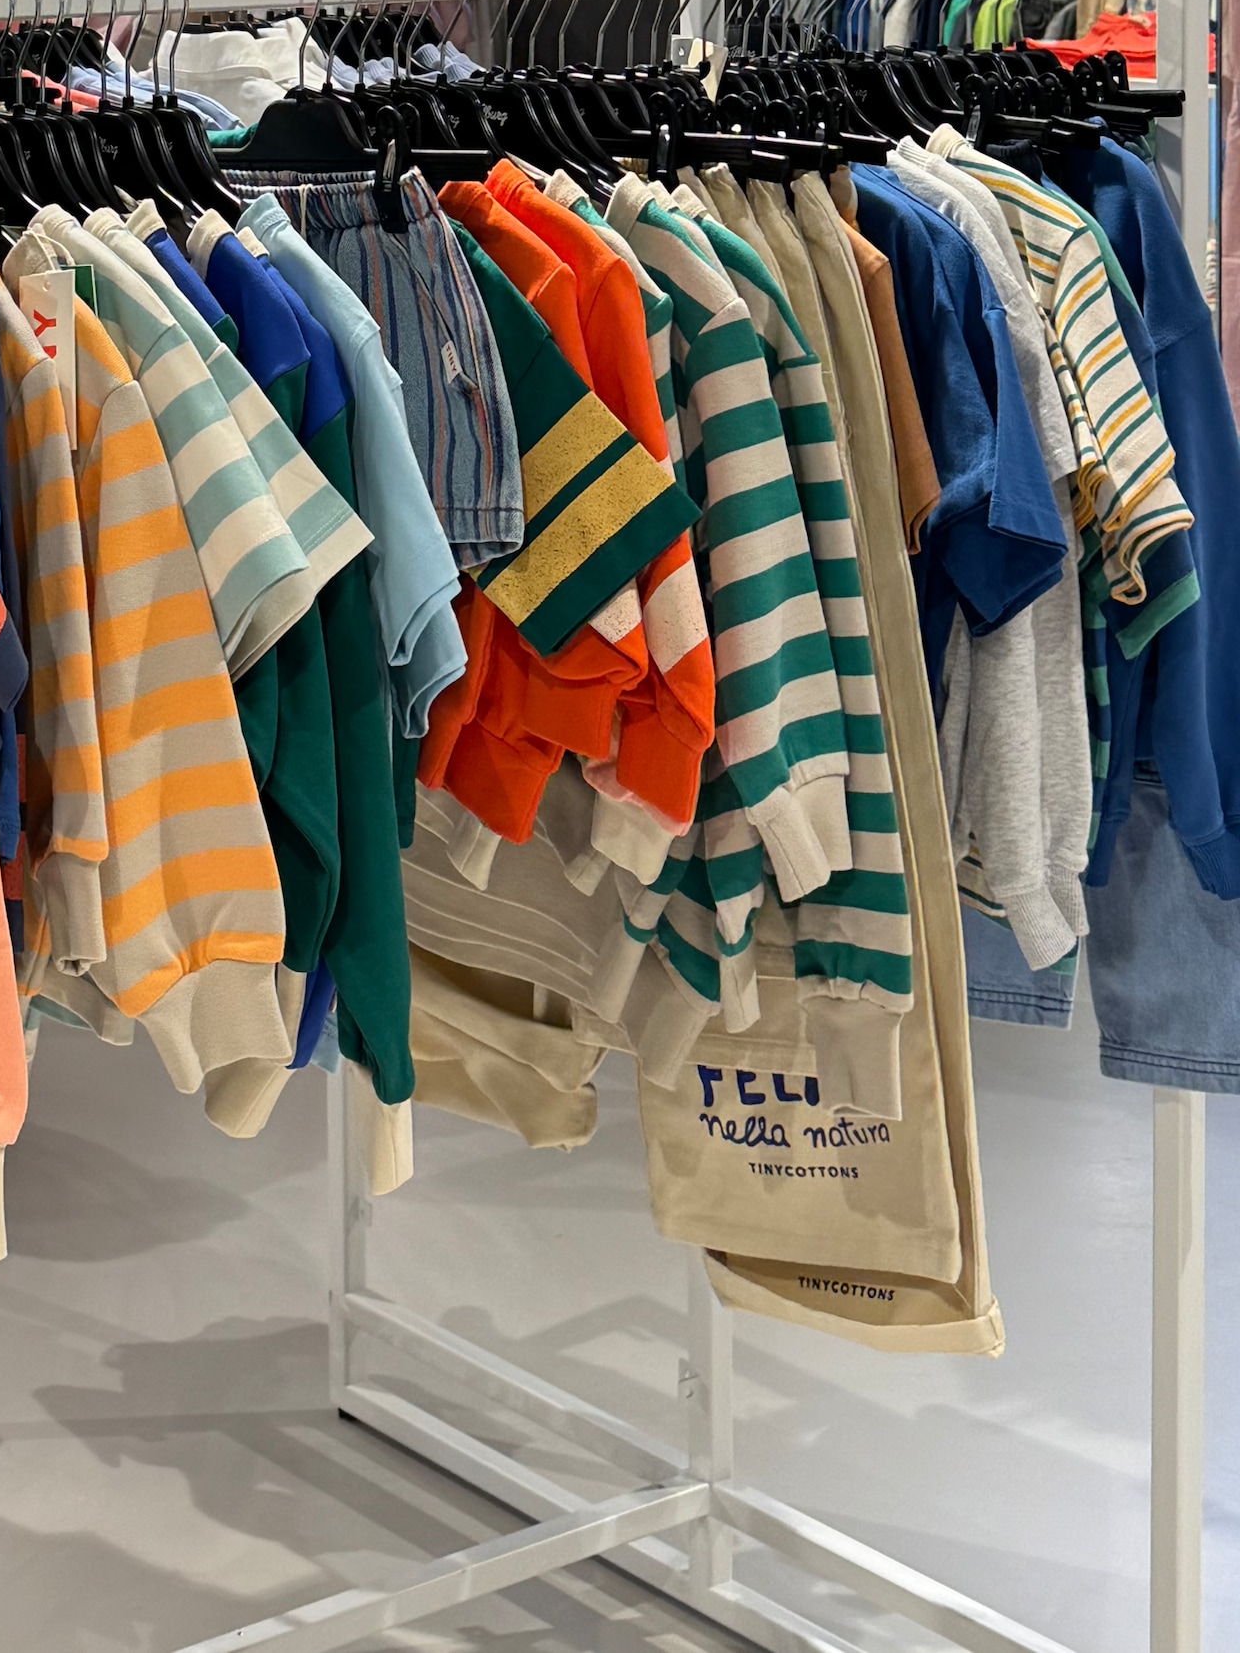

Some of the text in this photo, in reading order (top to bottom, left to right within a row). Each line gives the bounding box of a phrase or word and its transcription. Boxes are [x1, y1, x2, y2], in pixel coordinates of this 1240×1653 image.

[699, 1112, 891, 1150] nella natura
[748, 1161, 860, 1180] TINYCOTTONS
[797, 1275, 896, 1302] TINYCOTTONS
